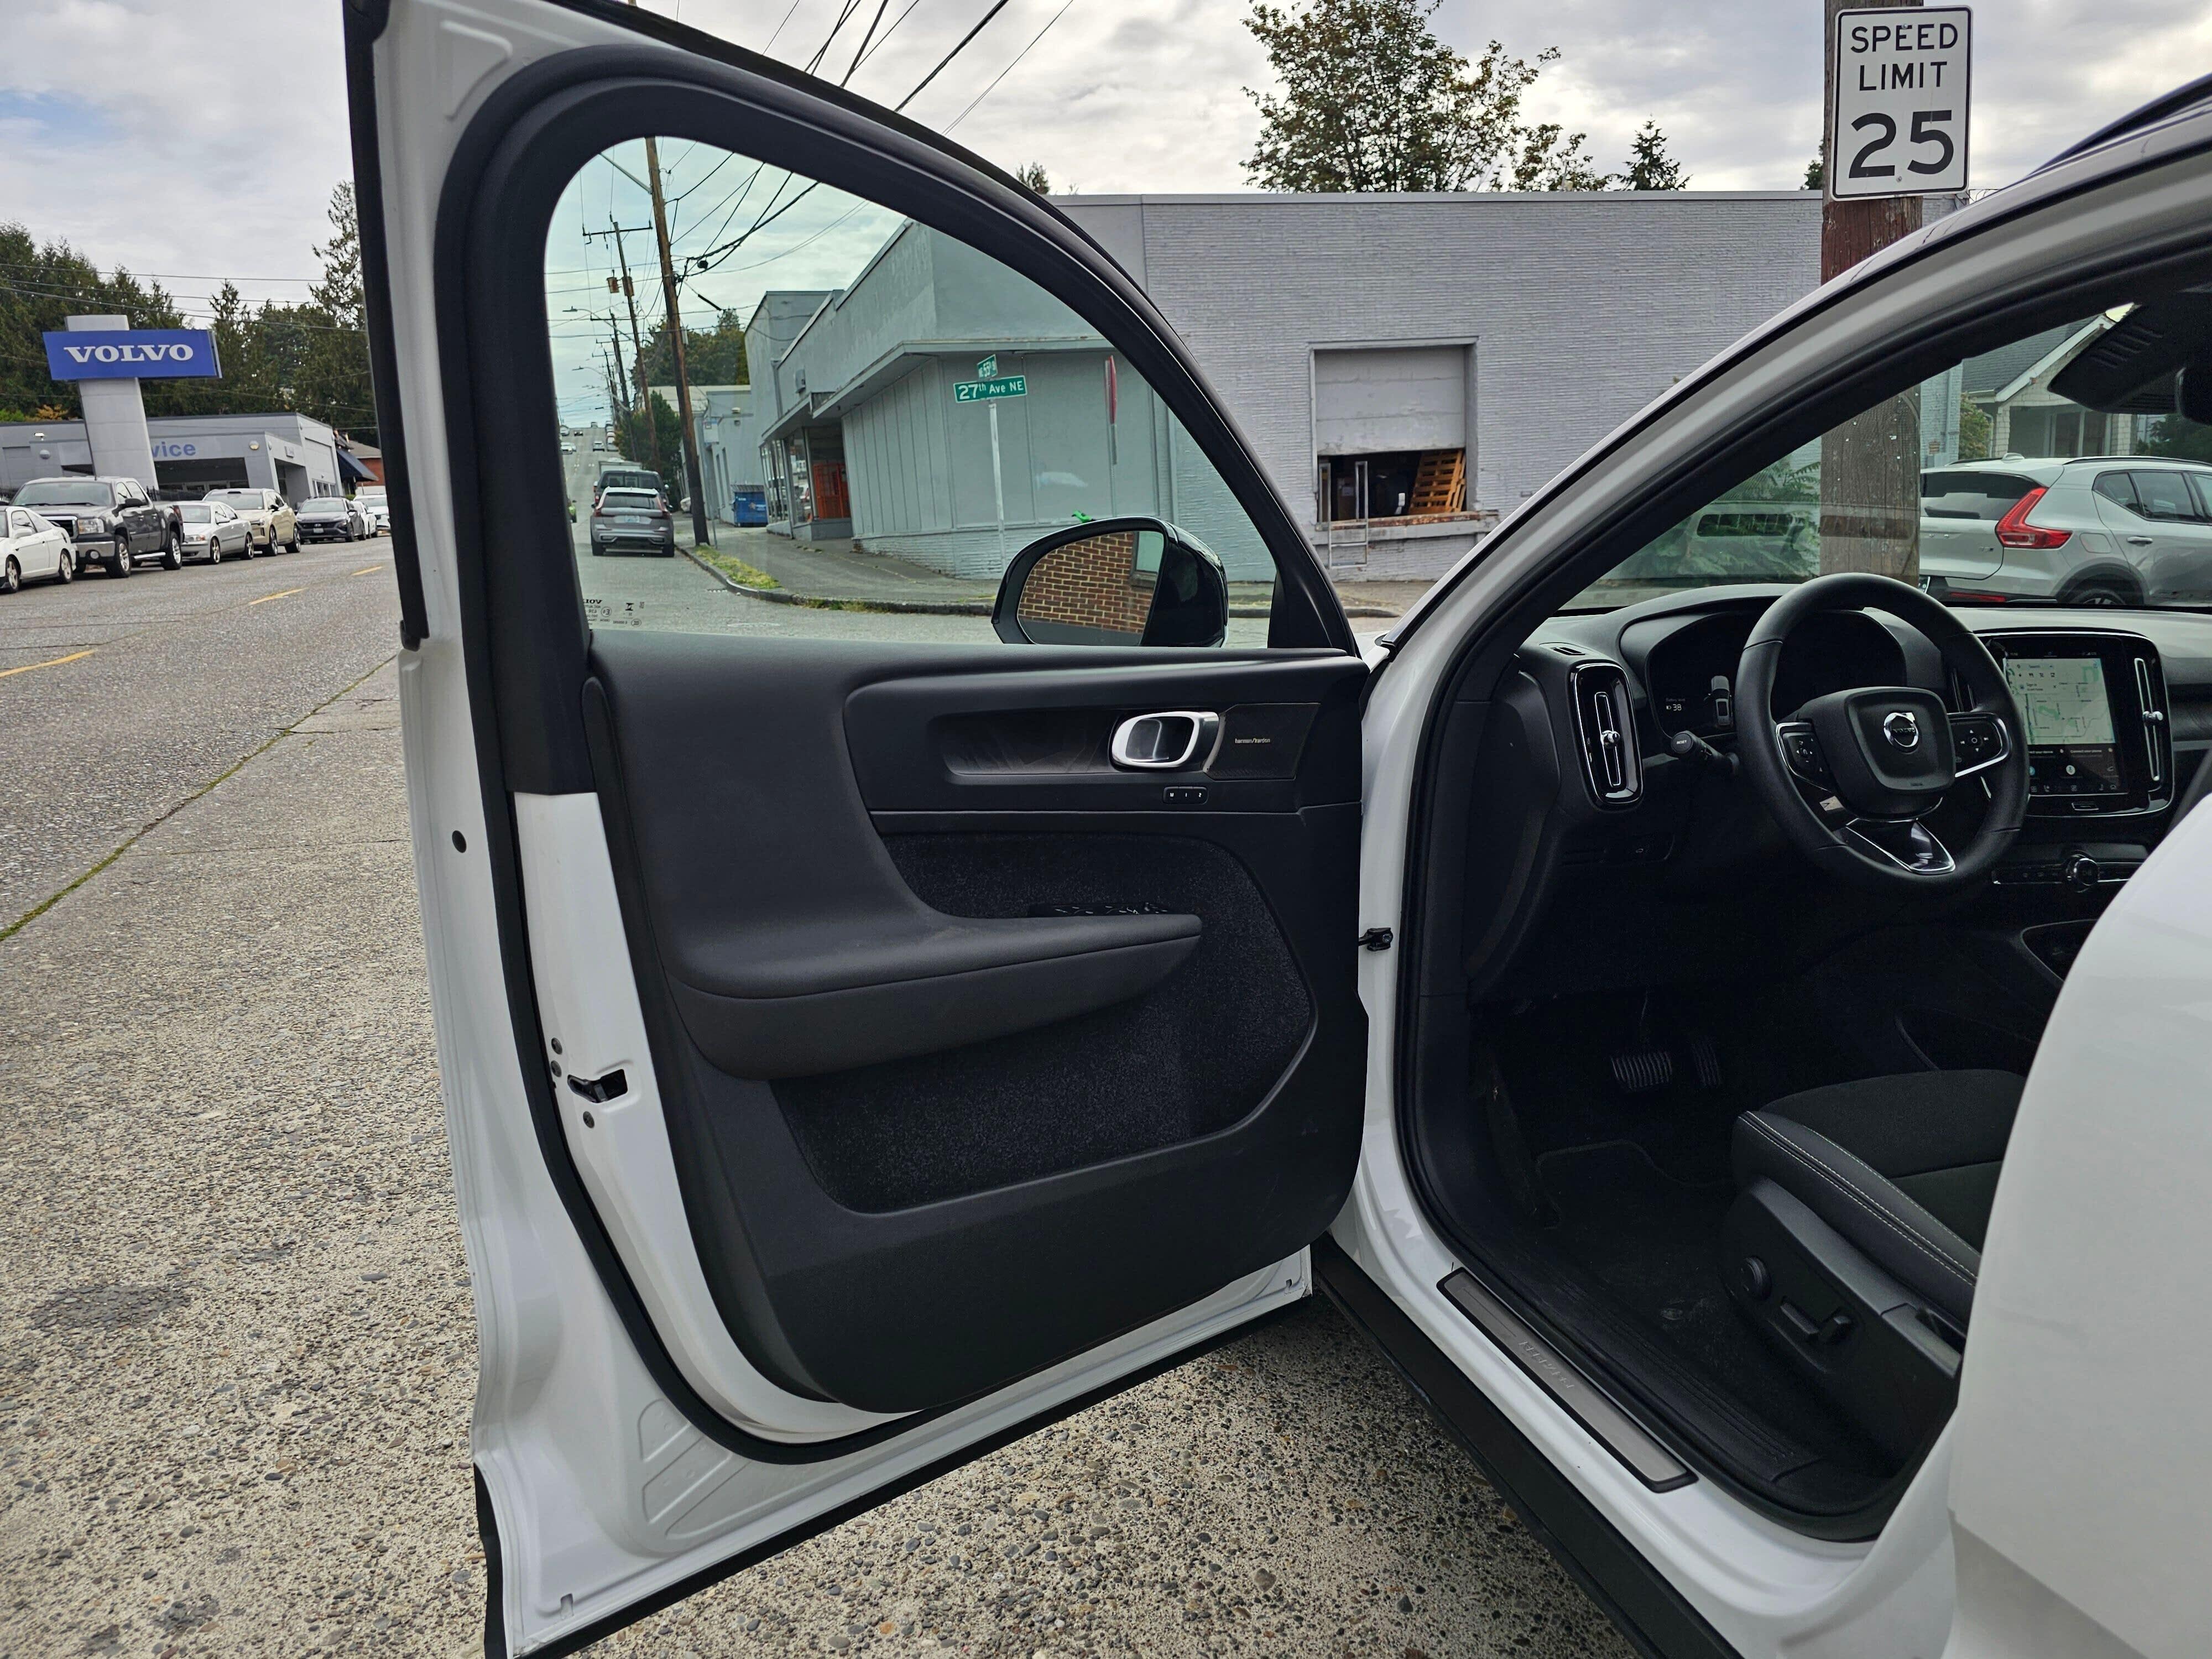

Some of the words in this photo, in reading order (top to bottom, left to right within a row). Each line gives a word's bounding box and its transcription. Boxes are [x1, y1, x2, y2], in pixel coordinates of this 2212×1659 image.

[1850, 23, 1958, 53] SPEED
[1859, 61, 1948, 91] LIMIT
[1849, 109, 1954, 179] 25
[63, 344, 194, 363] VOLVO
[958, 383, 987, 399] 27th
[989, 384, 1006, 394] Ave
[1009, 380, 1024, 392] NE
[151, 441, 196, 457] vice
